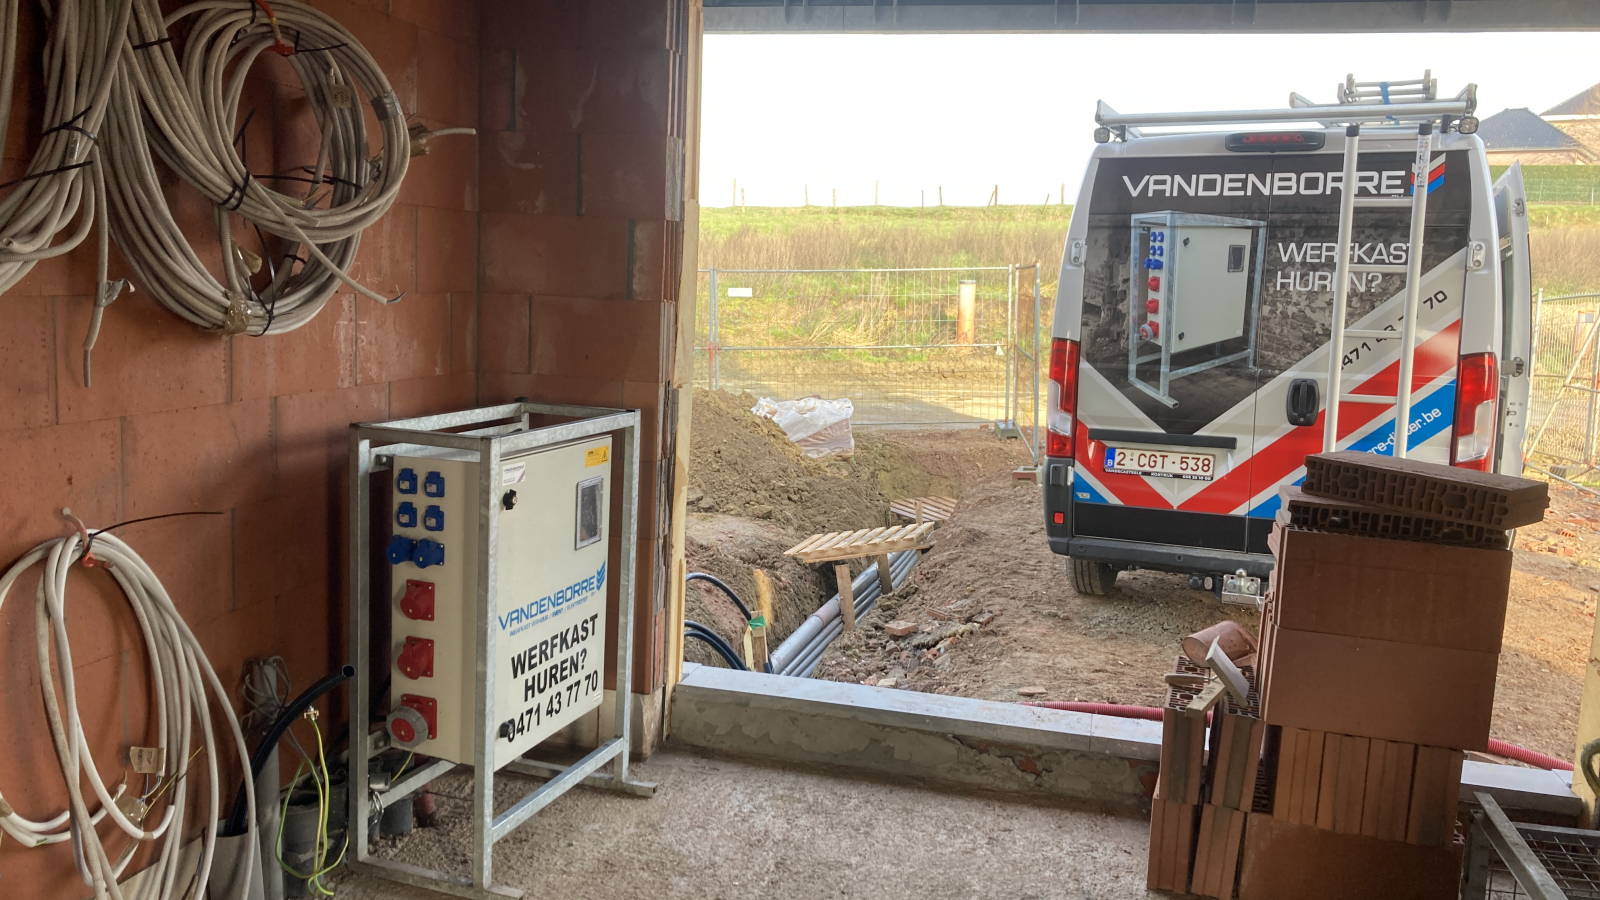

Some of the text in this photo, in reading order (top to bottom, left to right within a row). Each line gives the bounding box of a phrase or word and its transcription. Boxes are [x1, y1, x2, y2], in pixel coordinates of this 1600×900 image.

[1341, 341, 1372, 371] 471
[1422, 289, 1448, 310] 70
[1107, 459, 1113, 467] B
[498, 575, 596, 631] VANDENBORRE
[511, 612, 599, 680] WERFKAST
[524, 647, 588, 703] HUREN?
[506, 669, 598, 743] 0471 43 77 70
